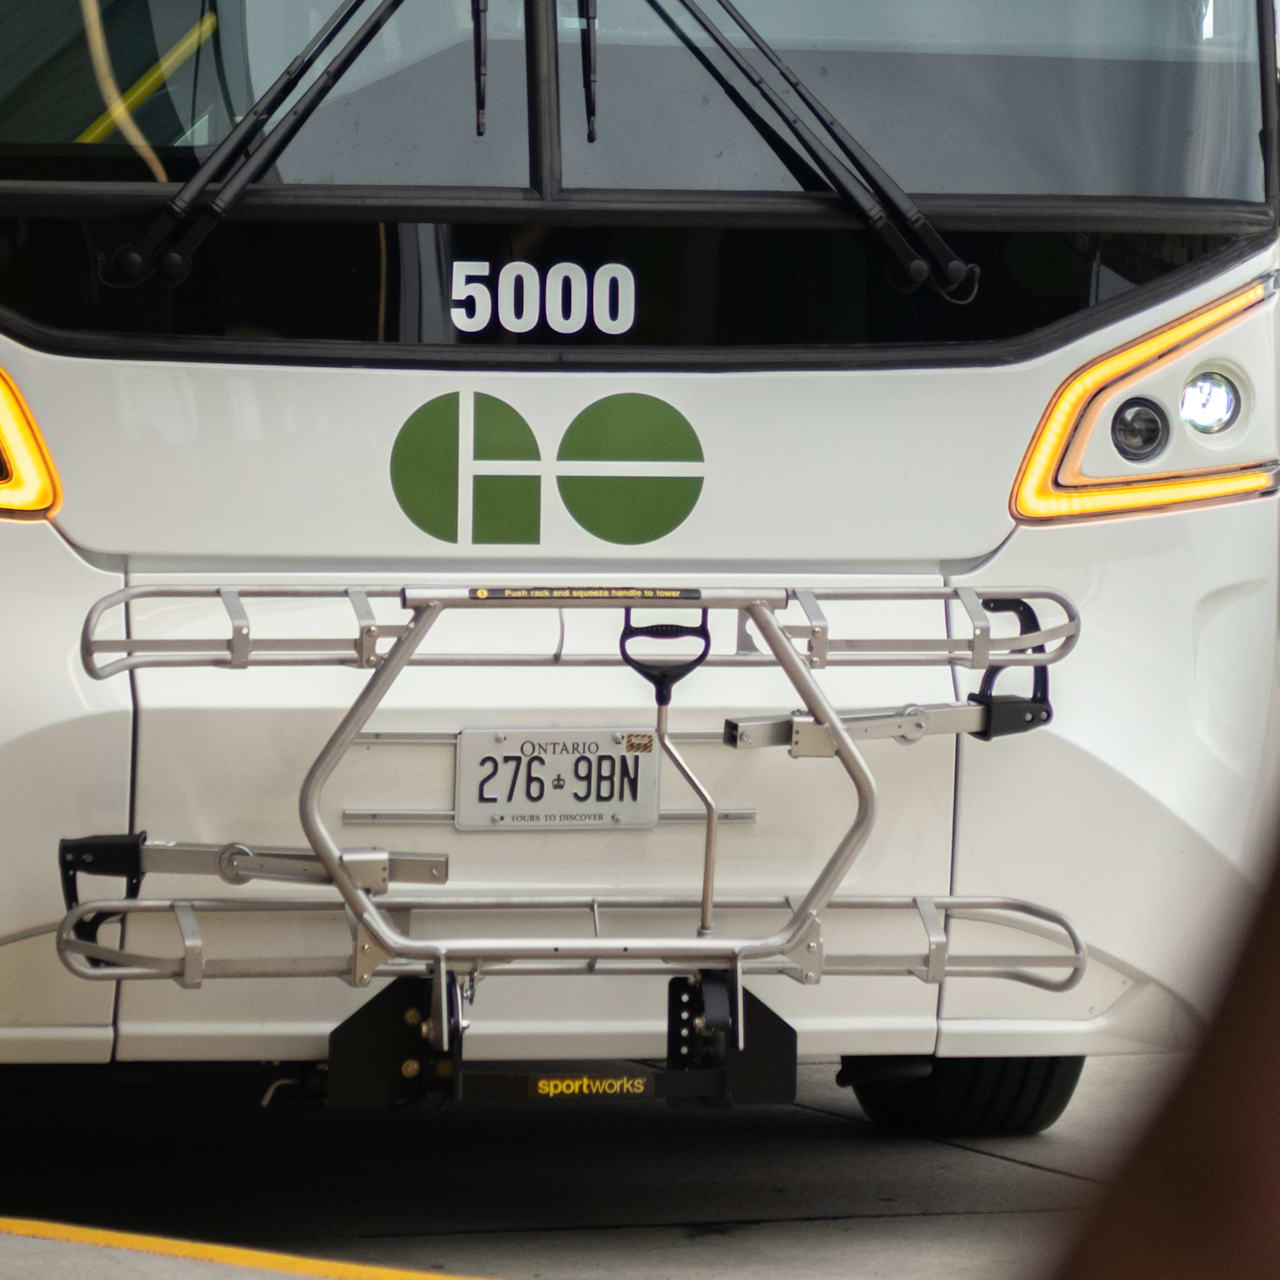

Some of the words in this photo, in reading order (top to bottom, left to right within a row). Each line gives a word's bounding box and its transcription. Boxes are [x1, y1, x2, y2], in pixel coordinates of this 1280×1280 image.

[450, 261, 636, 335] 5000
[390, 391, 705, 545] GO
[504, 589, 528, 598] Push
[531, 589, 550, 598] rack
[552, 589, 570, 598] and
[572, 589, 609, 599] squeeze
[612, 588, 641, 598] handle
[644, 589, 654, 598] to
[656, 589, 680, 598] lower
[520, 740, 600, 757] ONTARIO
[478, 755, 545, 803] 276
[573, 755, 639, 802] 9BN
[510, 813, 540, 822] YOURS
[544, 814, 556, 822] TO
[559, 813, 604, 821] DISCOVER
[537, 1075, 645, 1098] sportworks
